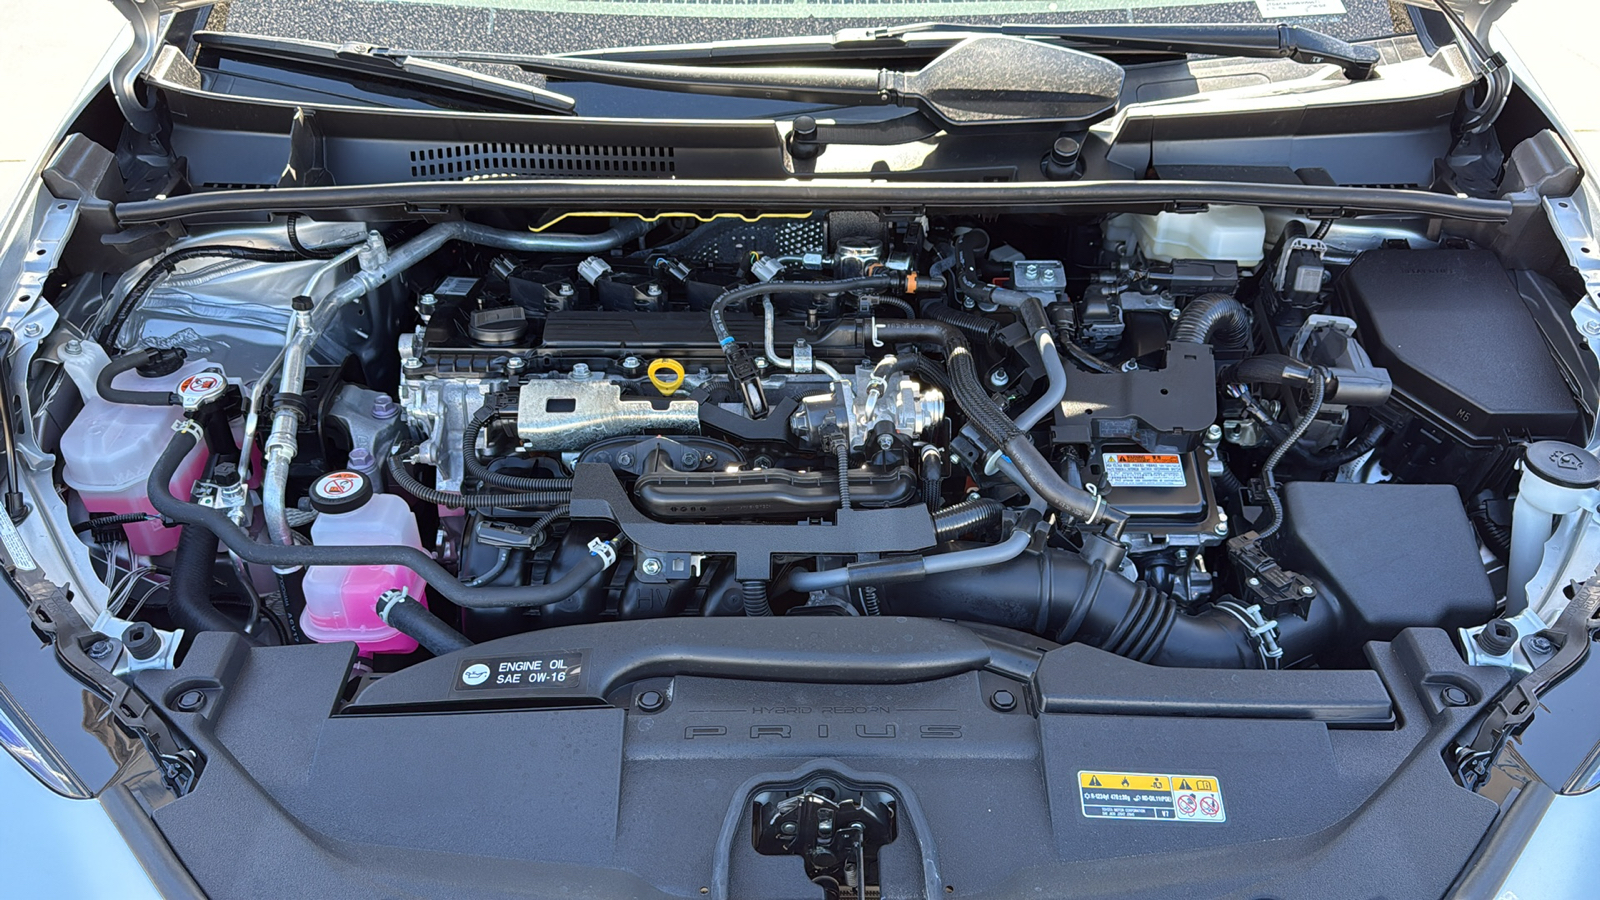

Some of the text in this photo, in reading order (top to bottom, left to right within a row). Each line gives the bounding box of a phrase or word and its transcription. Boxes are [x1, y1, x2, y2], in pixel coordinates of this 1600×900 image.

[636, 588, 672, 609] HV
[498, 659, 568, 672] ENGINE OIL
[496, 671, 566, 684] SAE 0W-16
[752, 706, 891, 715] HYBRID REBORN
[684, 724, 963, 740] PRIUS
